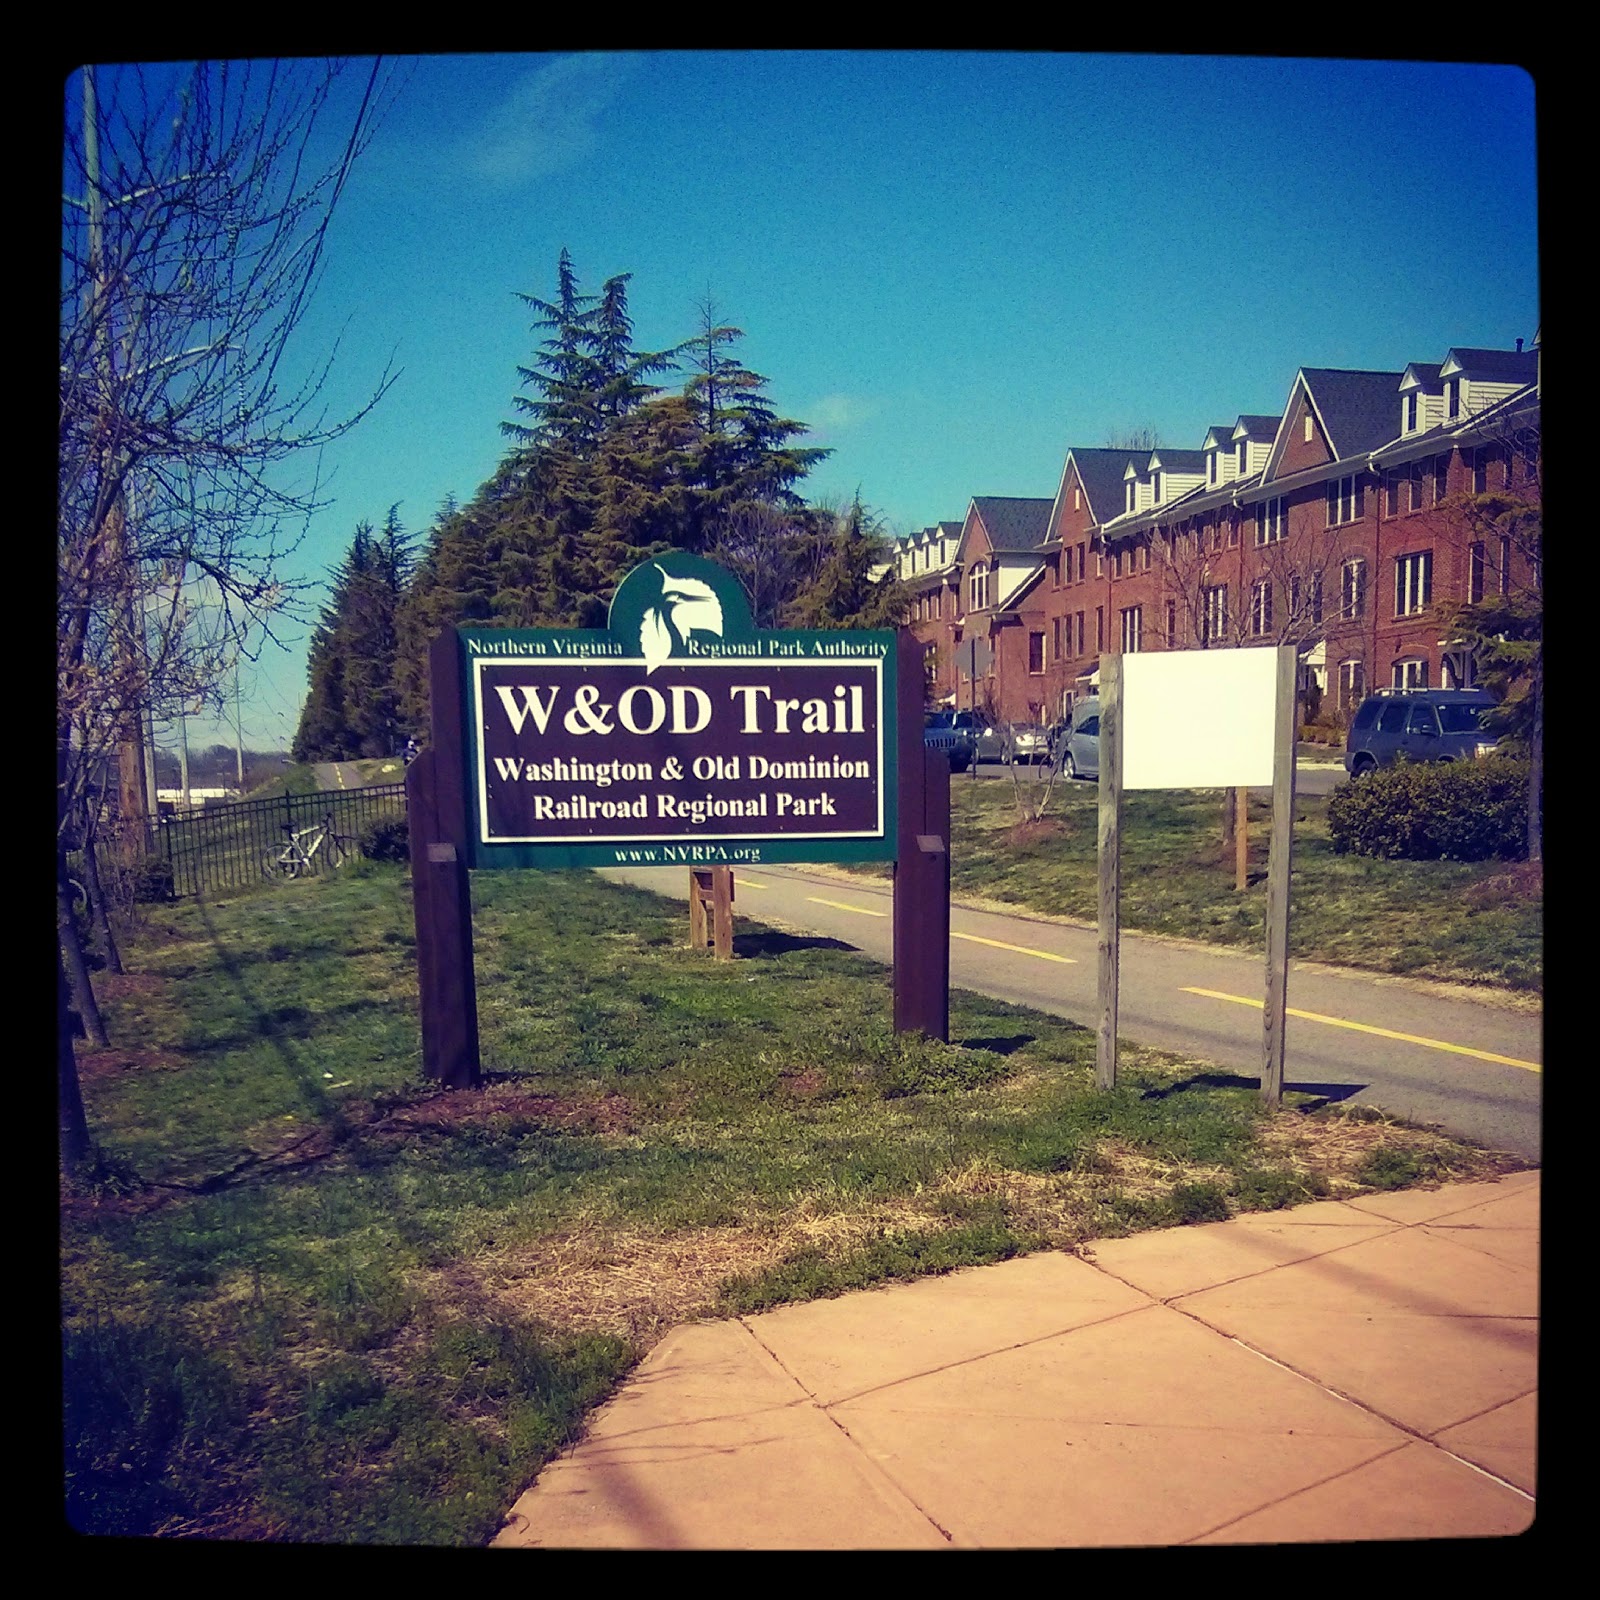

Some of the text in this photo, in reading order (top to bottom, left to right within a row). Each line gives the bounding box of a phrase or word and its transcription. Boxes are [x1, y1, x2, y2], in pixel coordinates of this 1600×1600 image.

[468, 638, 889, 660] Northern Virginia Regional Park Authority
[494, 684, 866, 735] W&OD Trail
[494, 754, 870, 787] Washington & Old Dominion
[533, 792, 837, 824] Railroad Regional Park
[614, 845, 761, 863] www.NVRPA.org
